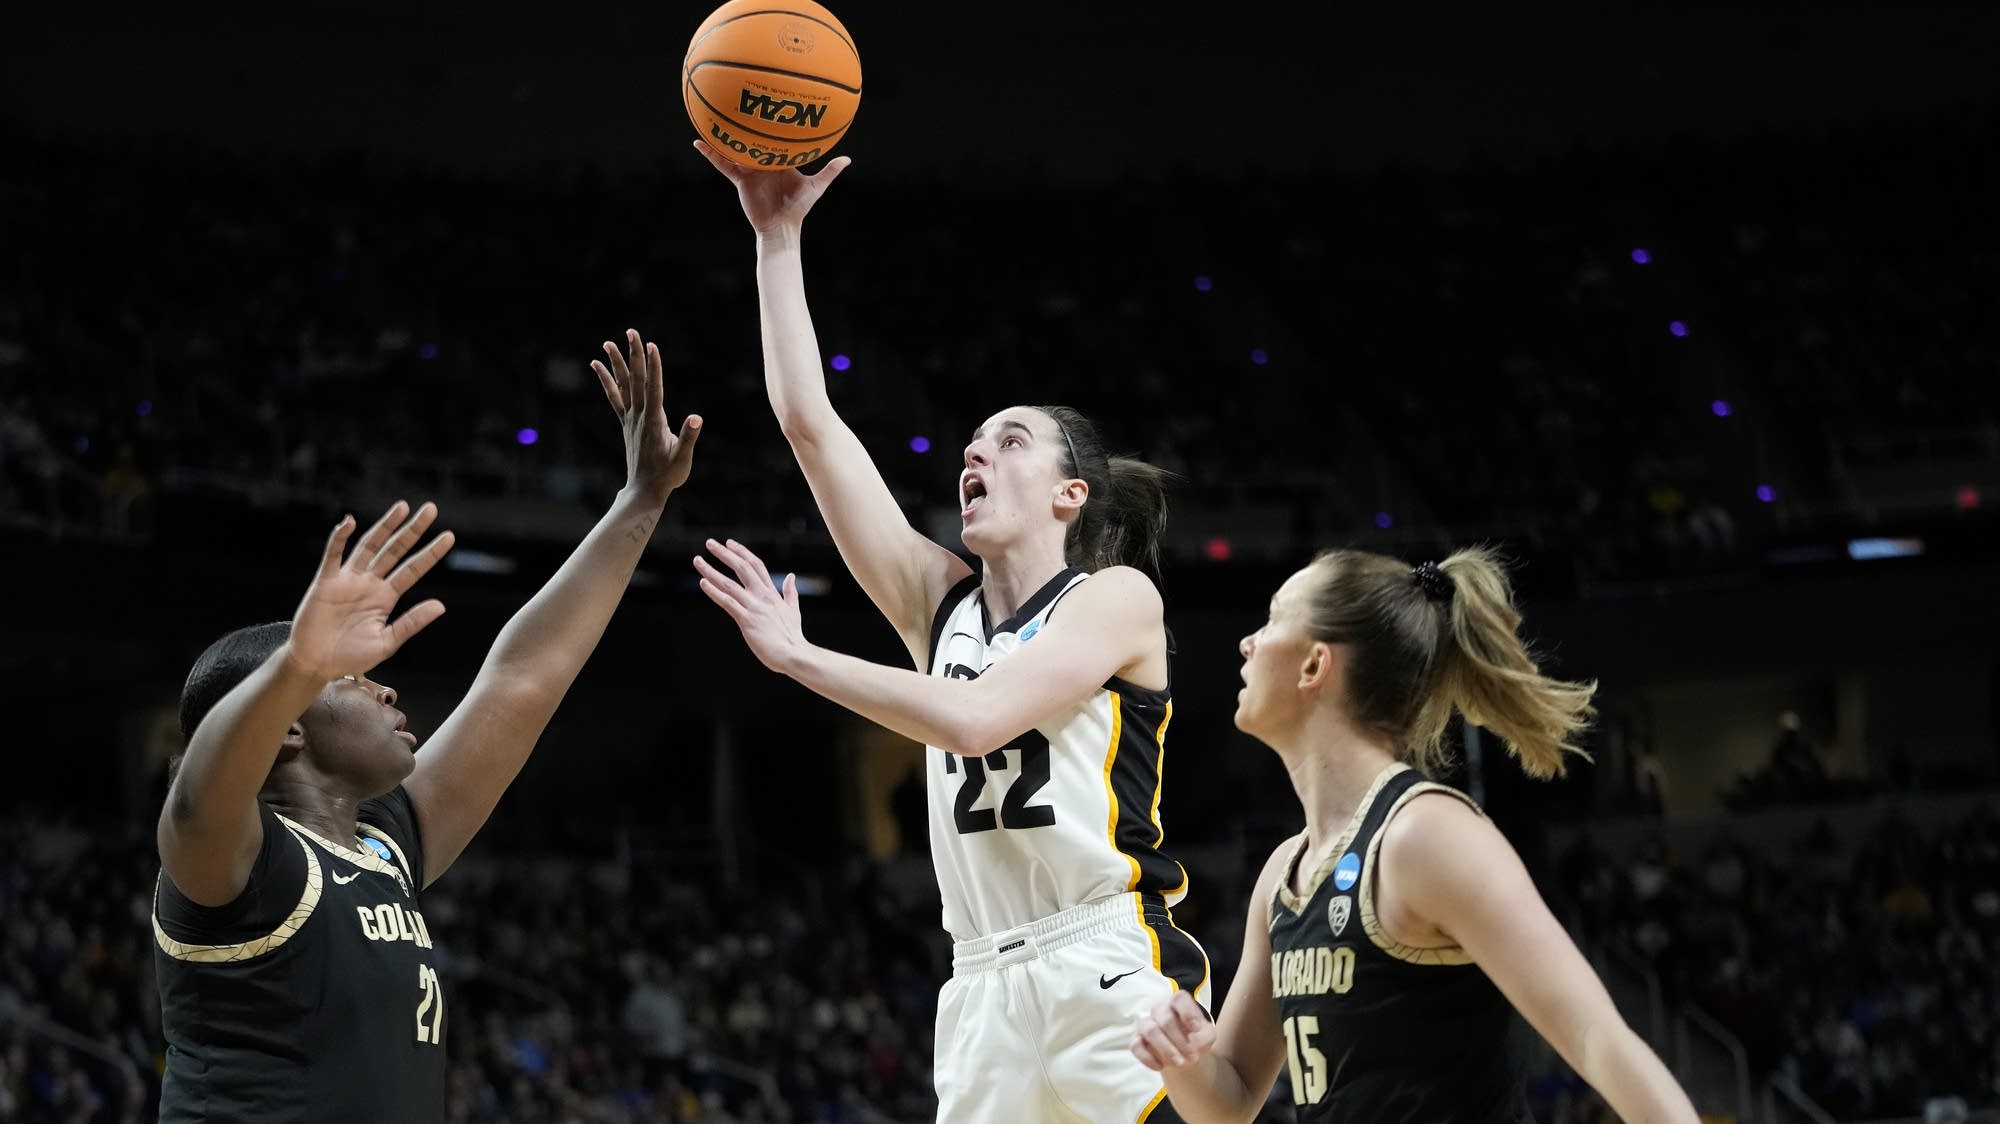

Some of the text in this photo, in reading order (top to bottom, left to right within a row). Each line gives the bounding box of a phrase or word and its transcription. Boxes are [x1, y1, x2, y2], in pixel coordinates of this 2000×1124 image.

[738, 87, 828, 129] NCAA
[710, 122, 821, 167] Wilson
[945, 728, 1056, 834] 22
[416, 963, 443, 1045] 21
[1271, 946, 1356, 999] LORADO
[1283, 1015, 1328, 1106] 15
